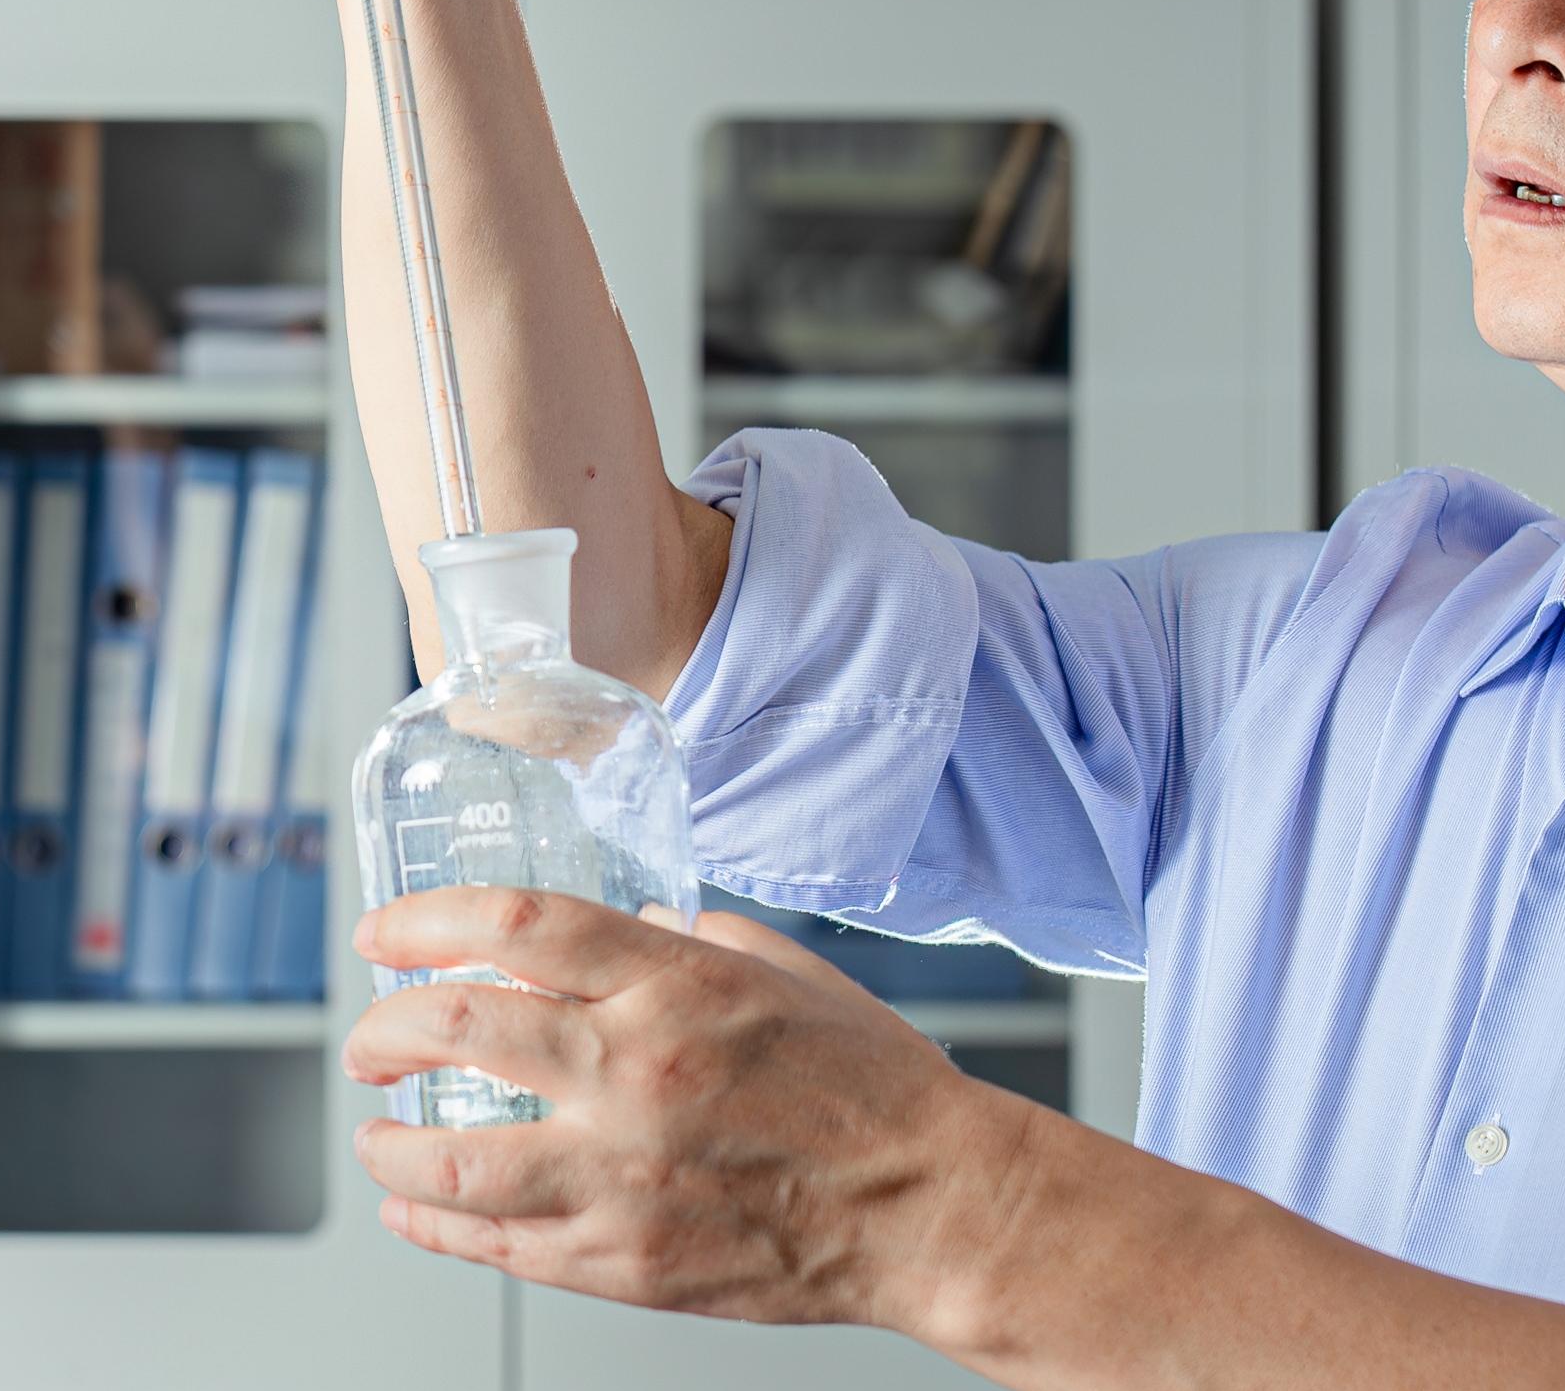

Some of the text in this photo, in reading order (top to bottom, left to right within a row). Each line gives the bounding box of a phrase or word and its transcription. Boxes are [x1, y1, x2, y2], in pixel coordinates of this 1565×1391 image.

[382, 22, 392, 38] 8
[393, 95, 403, 111] 7
[404, 168, 414, 186] 6
[416, 241, 425, 258] 5
[425, 314, 436, 331] 4
[458, 801, 512, 830] 400
